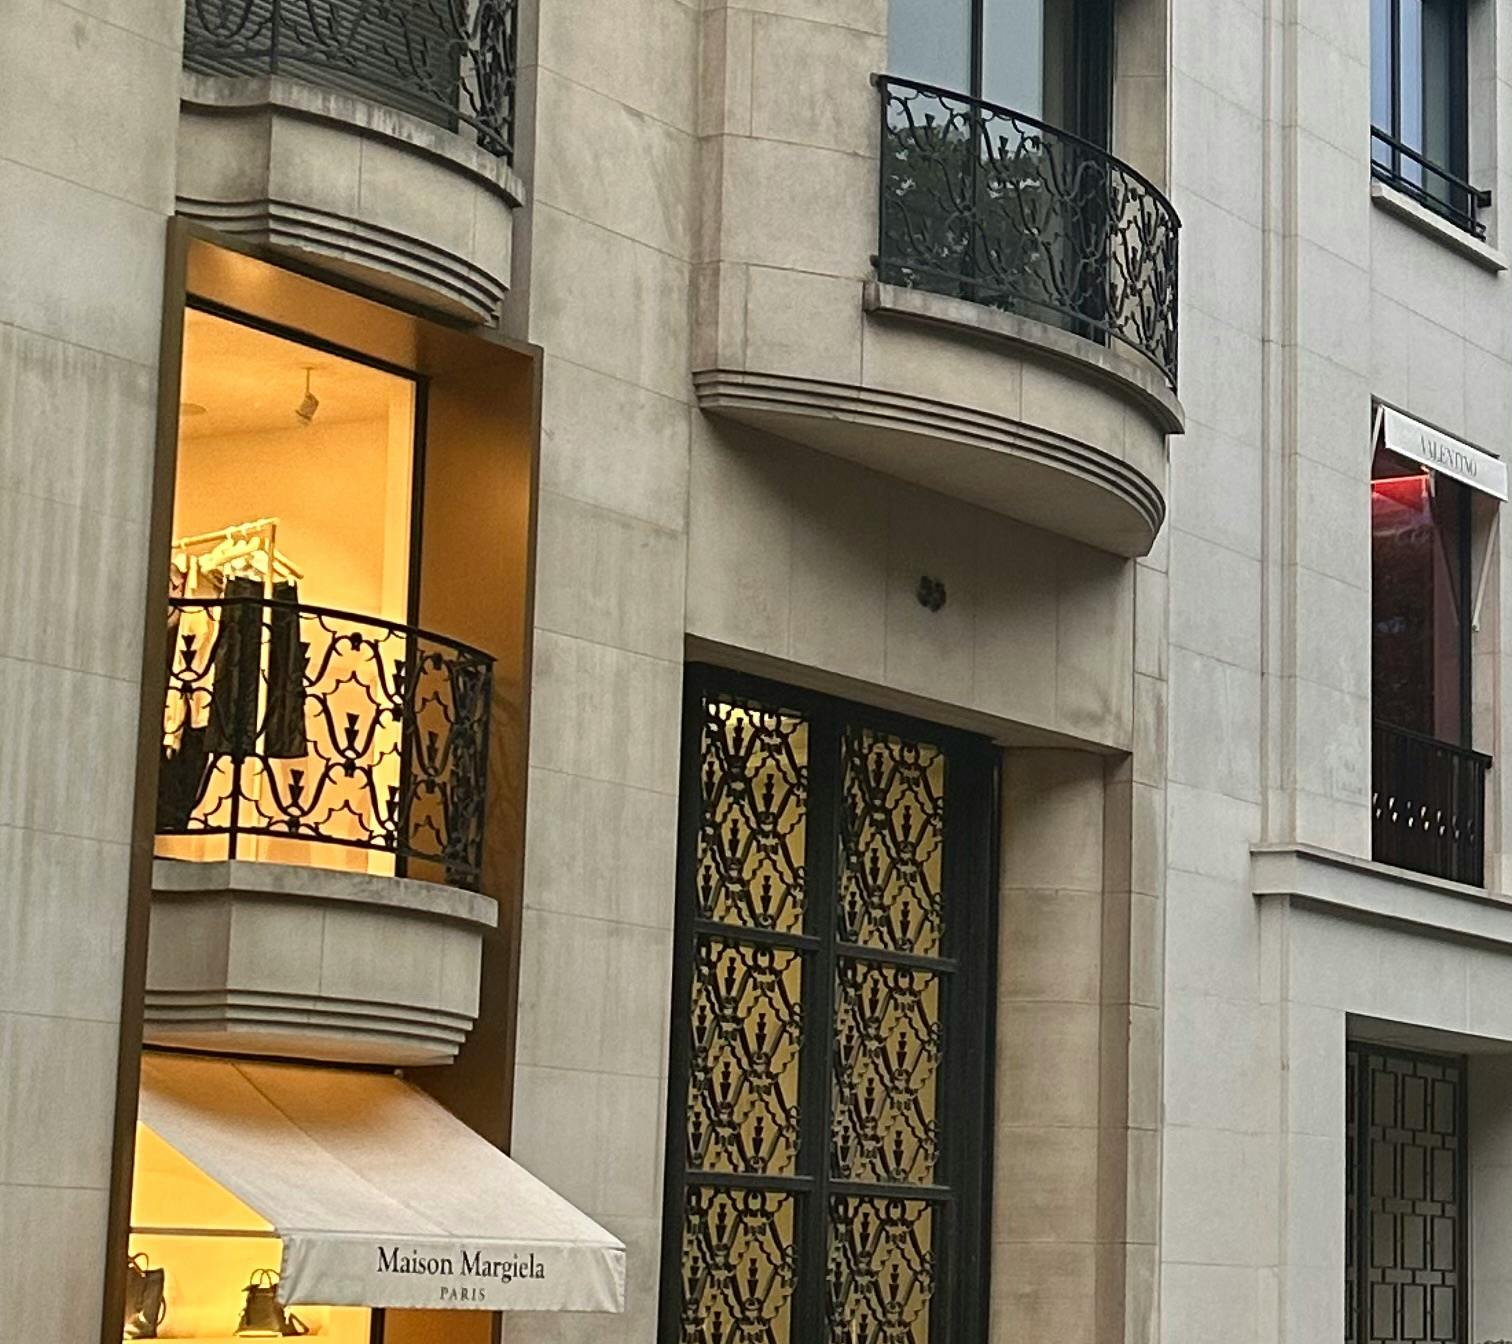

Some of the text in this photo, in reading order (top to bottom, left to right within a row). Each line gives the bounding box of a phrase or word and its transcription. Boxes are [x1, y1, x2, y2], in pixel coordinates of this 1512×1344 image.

[1420, 435, 1478, 477] VALENTINO
[377, 1246, 546, 1284] Maison Margiela
[440, 1286, 486, 1301] PARIS
